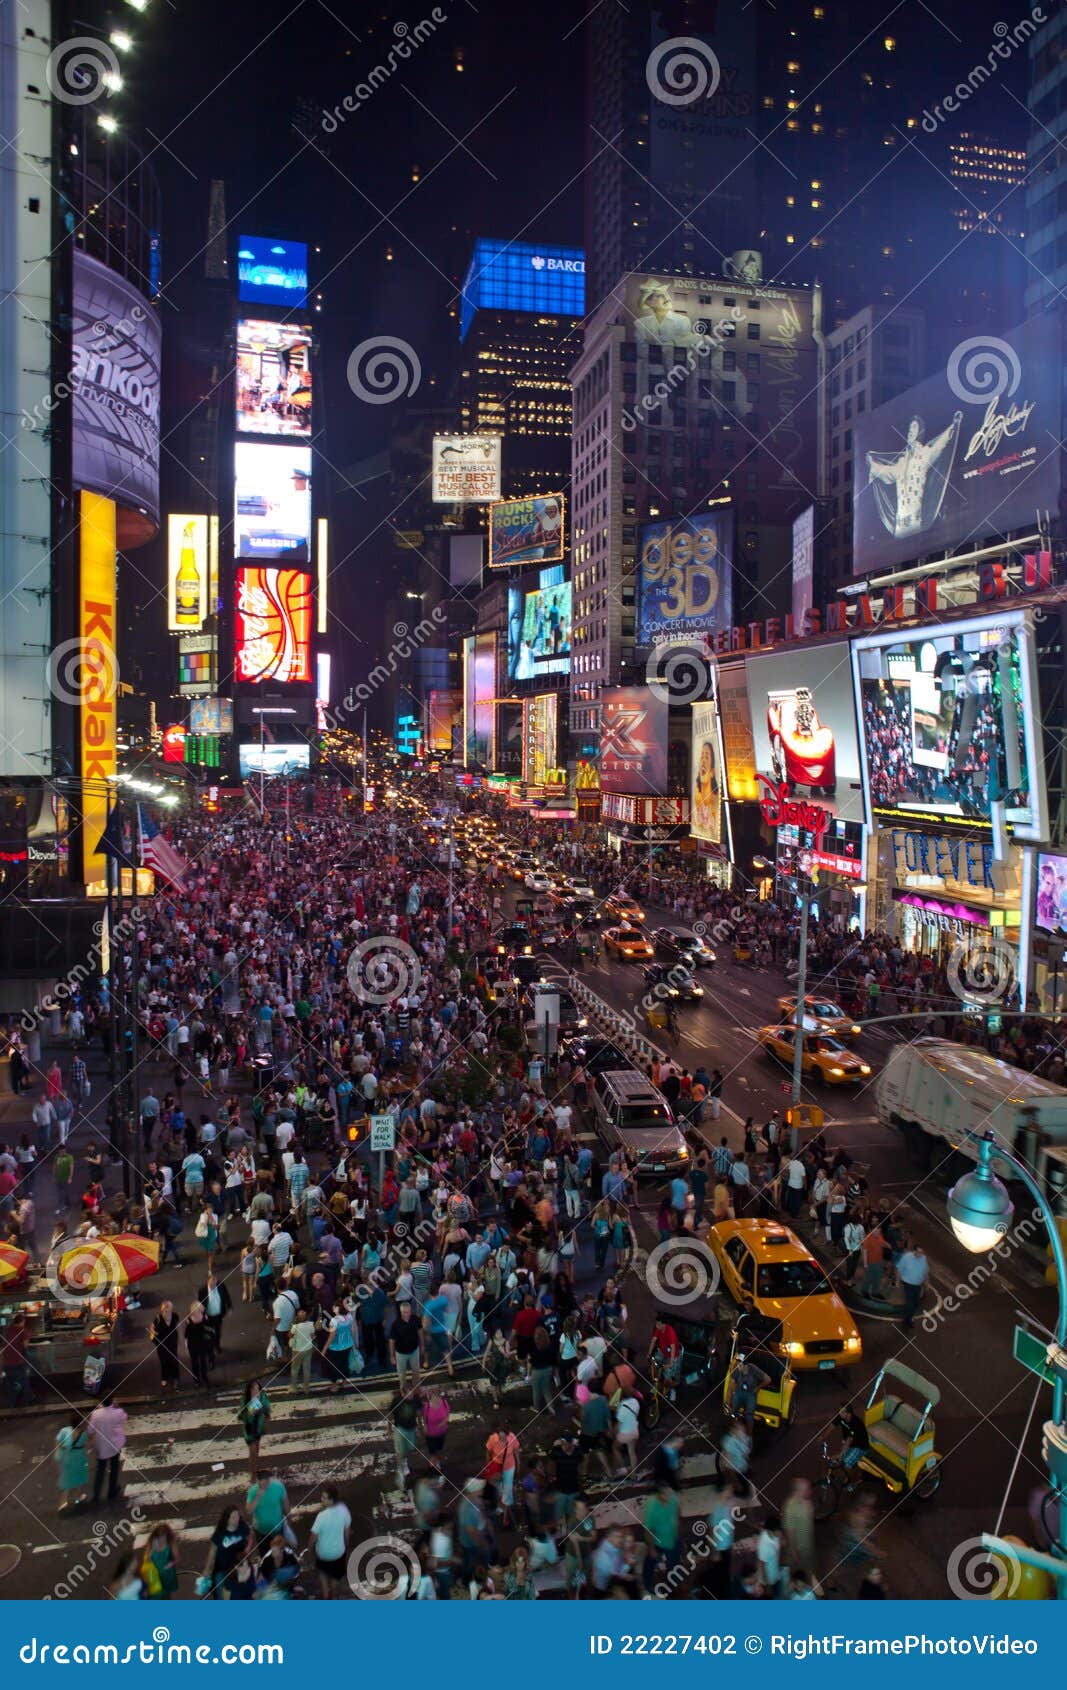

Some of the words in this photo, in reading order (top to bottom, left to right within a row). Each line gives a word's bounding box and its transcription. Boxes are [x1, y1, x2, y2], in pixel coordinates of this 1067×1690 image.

[465, 473, 496, 482] BEST
[483, 482, 496, 490] OF
[642, 525, 718, 581] glee
[655, 587, 669, 596] THE
[660, 565, 719, 619] 3D
[643, 618, 685, 633] CONCERT
[686, 616, 717, 629] MOVIE
[84, 600, 112, 784] Kodak
[528, 703, 536, 766] PALACE
[891, 829, 995, 890] FOREVER
